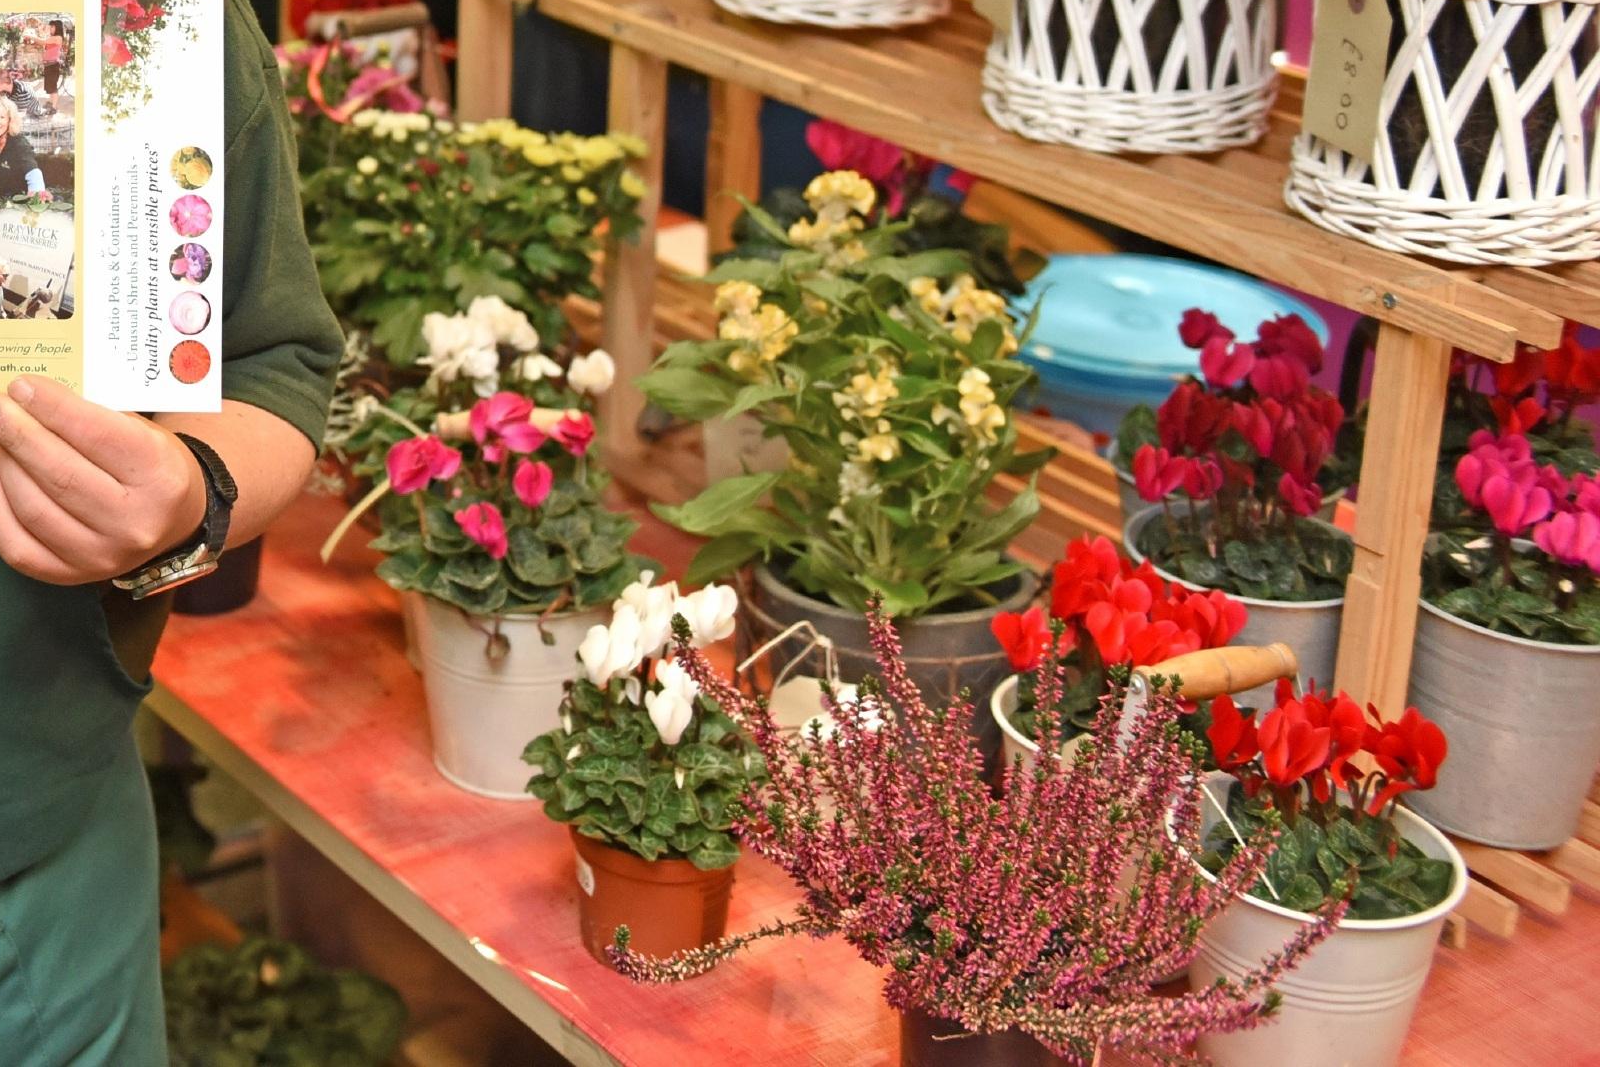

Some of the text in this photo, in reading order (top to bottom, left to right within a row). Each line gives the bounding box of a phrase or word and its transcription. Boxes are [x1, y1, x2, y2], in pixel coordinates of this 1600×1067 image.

[126, 164, 138, 230] Perennials
[108, 184, 120, 257] Containers
[144, 196, 159, 253] sensible
[108, 260, 120, 272] &
[126, 234, 138, 258] and
[147, 256, 158, 272] at
[108, 275, 120, 303] Pots
[127, 260, 138, 305] Shrubs
[144, 276, 162, 321] plants
[108, 307, 120, 341] Patio
[127, 309, 138, 362] Unusual
